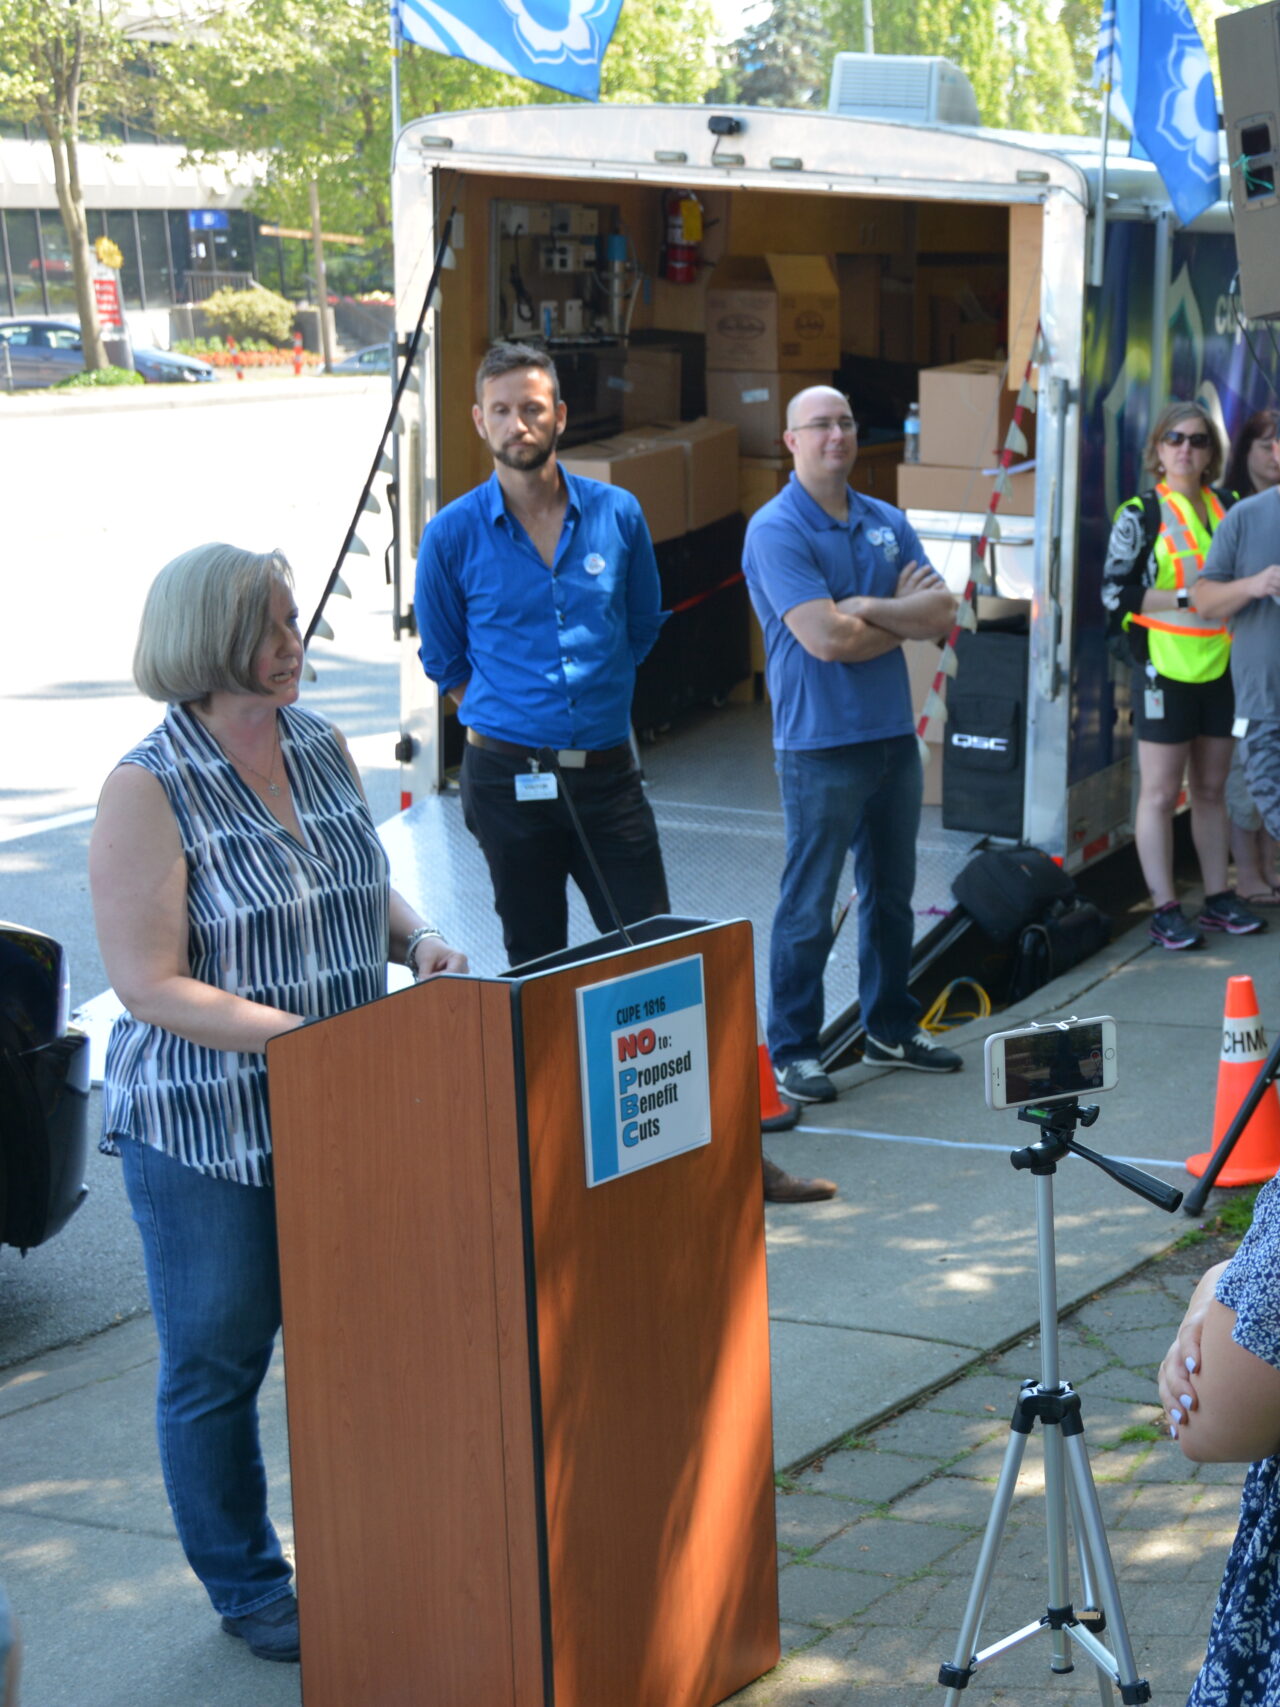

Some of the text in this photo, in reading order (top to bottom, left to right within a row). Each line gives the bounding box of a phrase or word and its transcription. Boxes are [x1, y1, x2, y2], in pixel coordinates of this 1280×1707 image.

[616, 995, 667, 1026] CUPE 1816
[617, 1027, 673, 1063] NO to:
[618, 1050, 692, 1096] Proposed
[620, 1083, 679, 1122] Benefit
[622, 1117, 661, 1148] Cuts
